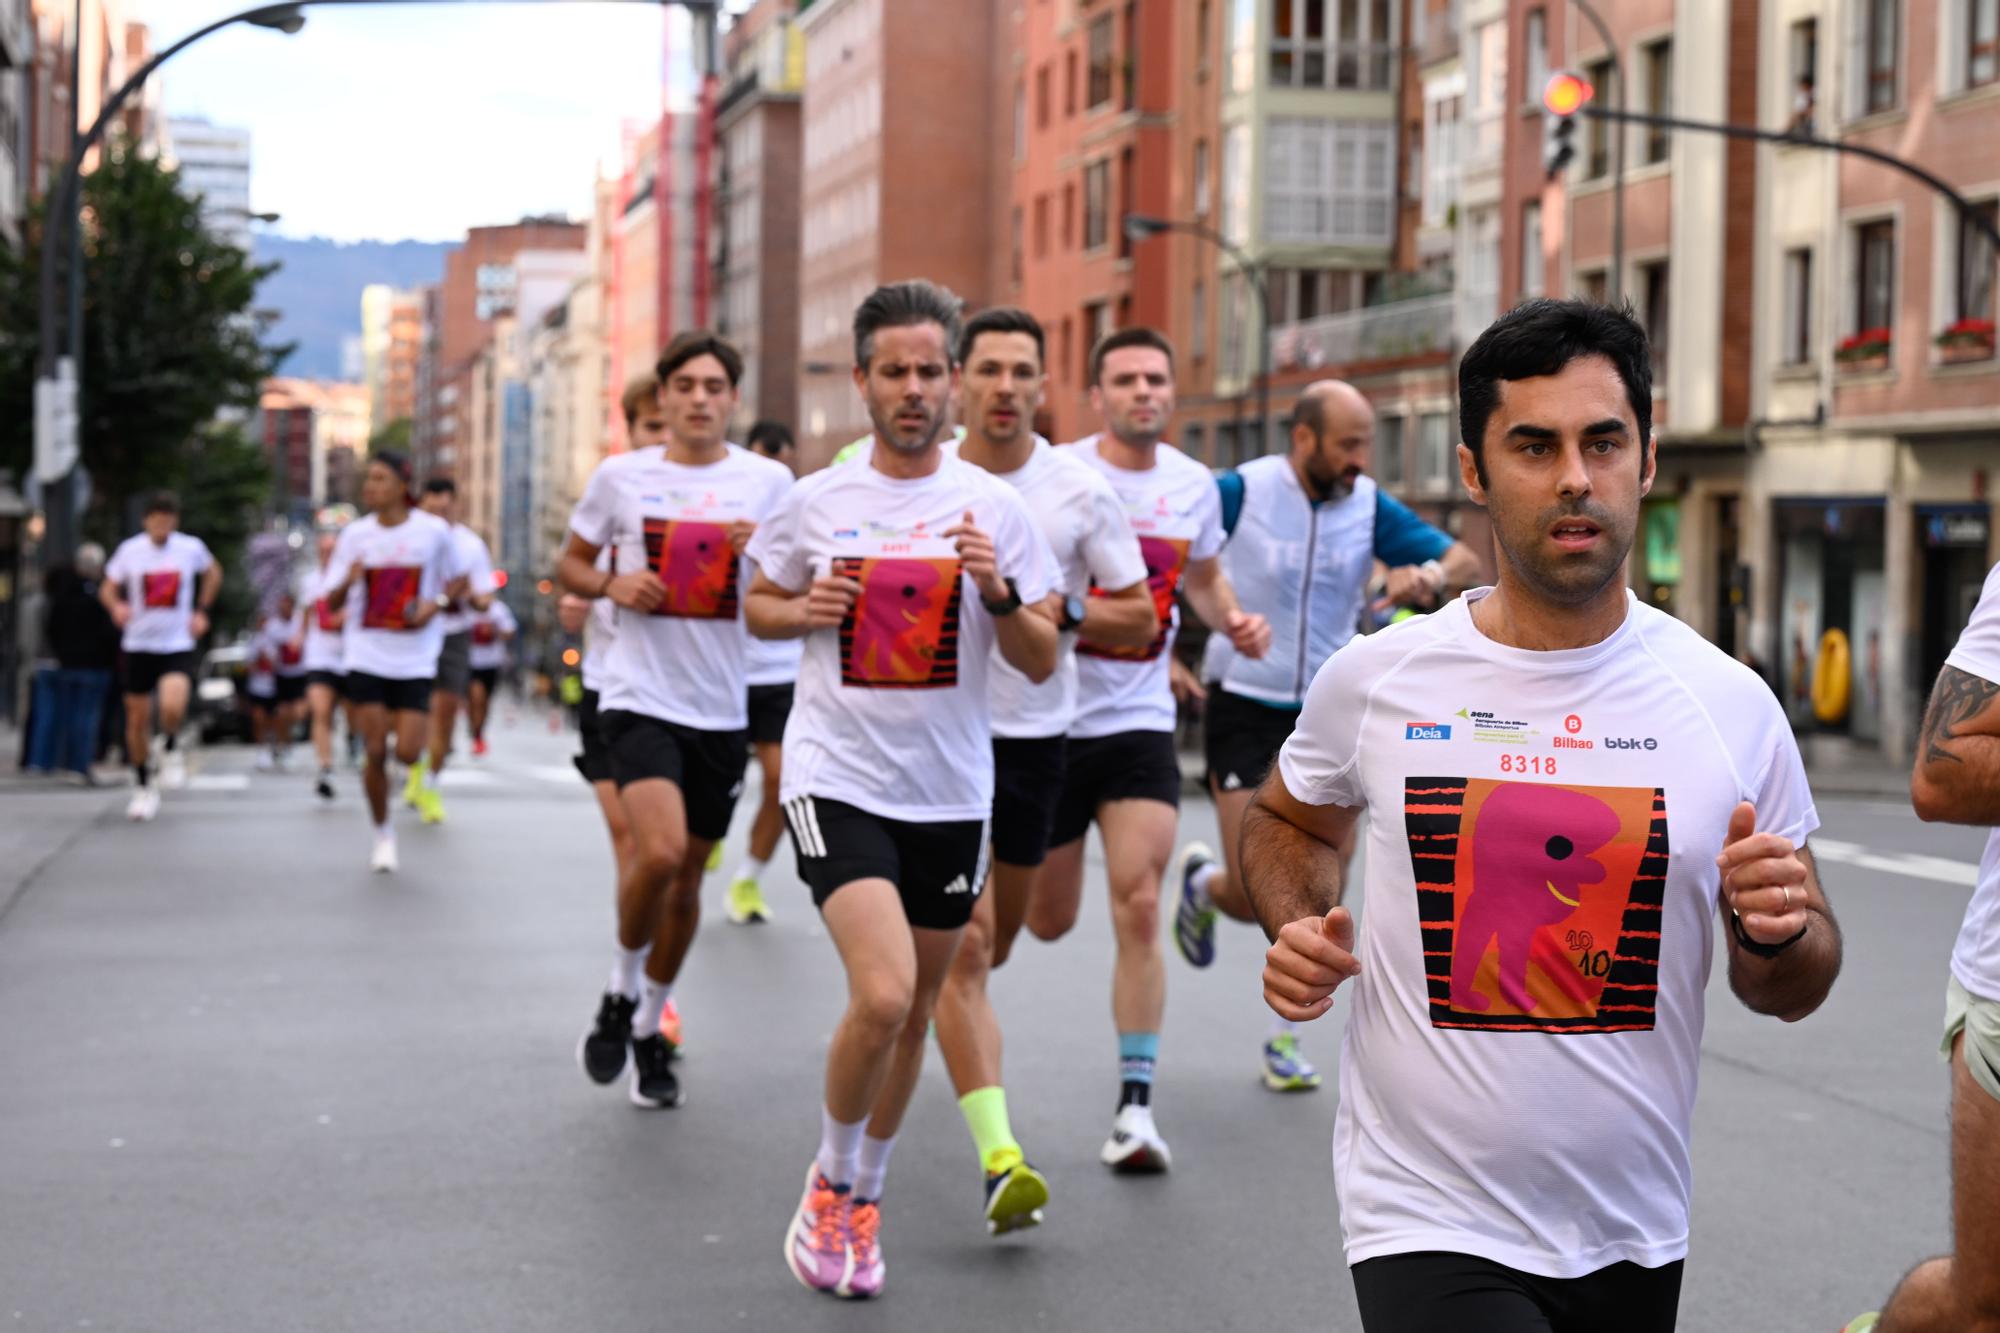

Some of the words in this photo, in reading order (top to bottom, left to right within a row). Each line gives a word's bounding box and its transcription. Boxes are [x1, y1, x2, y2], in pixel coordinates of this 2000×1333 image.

[1568, 719, 1578, 729] B
[1412, 727, 1442, 738] Deia
[1553, 736, 1593, 749] Bilbao
[1605, 737, 1642, 749] bbk
[1500, 754, 1557, 775] 8318
[1578, 950, 1611, 976] 10
